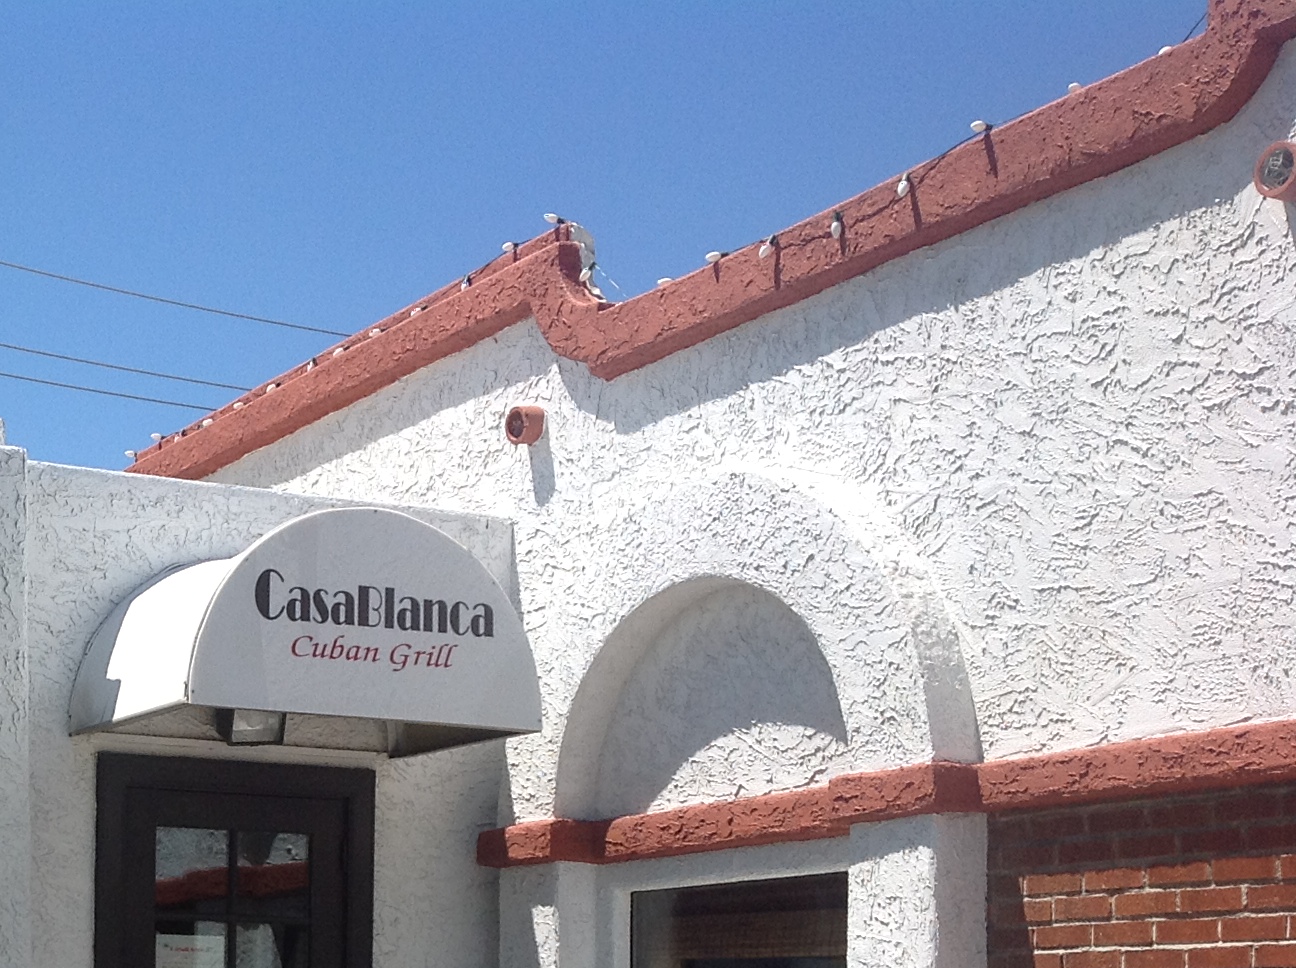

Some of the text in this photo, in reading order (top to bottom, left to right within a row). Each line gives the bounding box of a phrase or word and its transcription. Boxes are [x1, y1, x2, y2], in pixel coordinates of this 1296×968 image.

[255, 568, 494, 637] CasaBlanca
[290, 635, 458, 671] Cuban Grill
